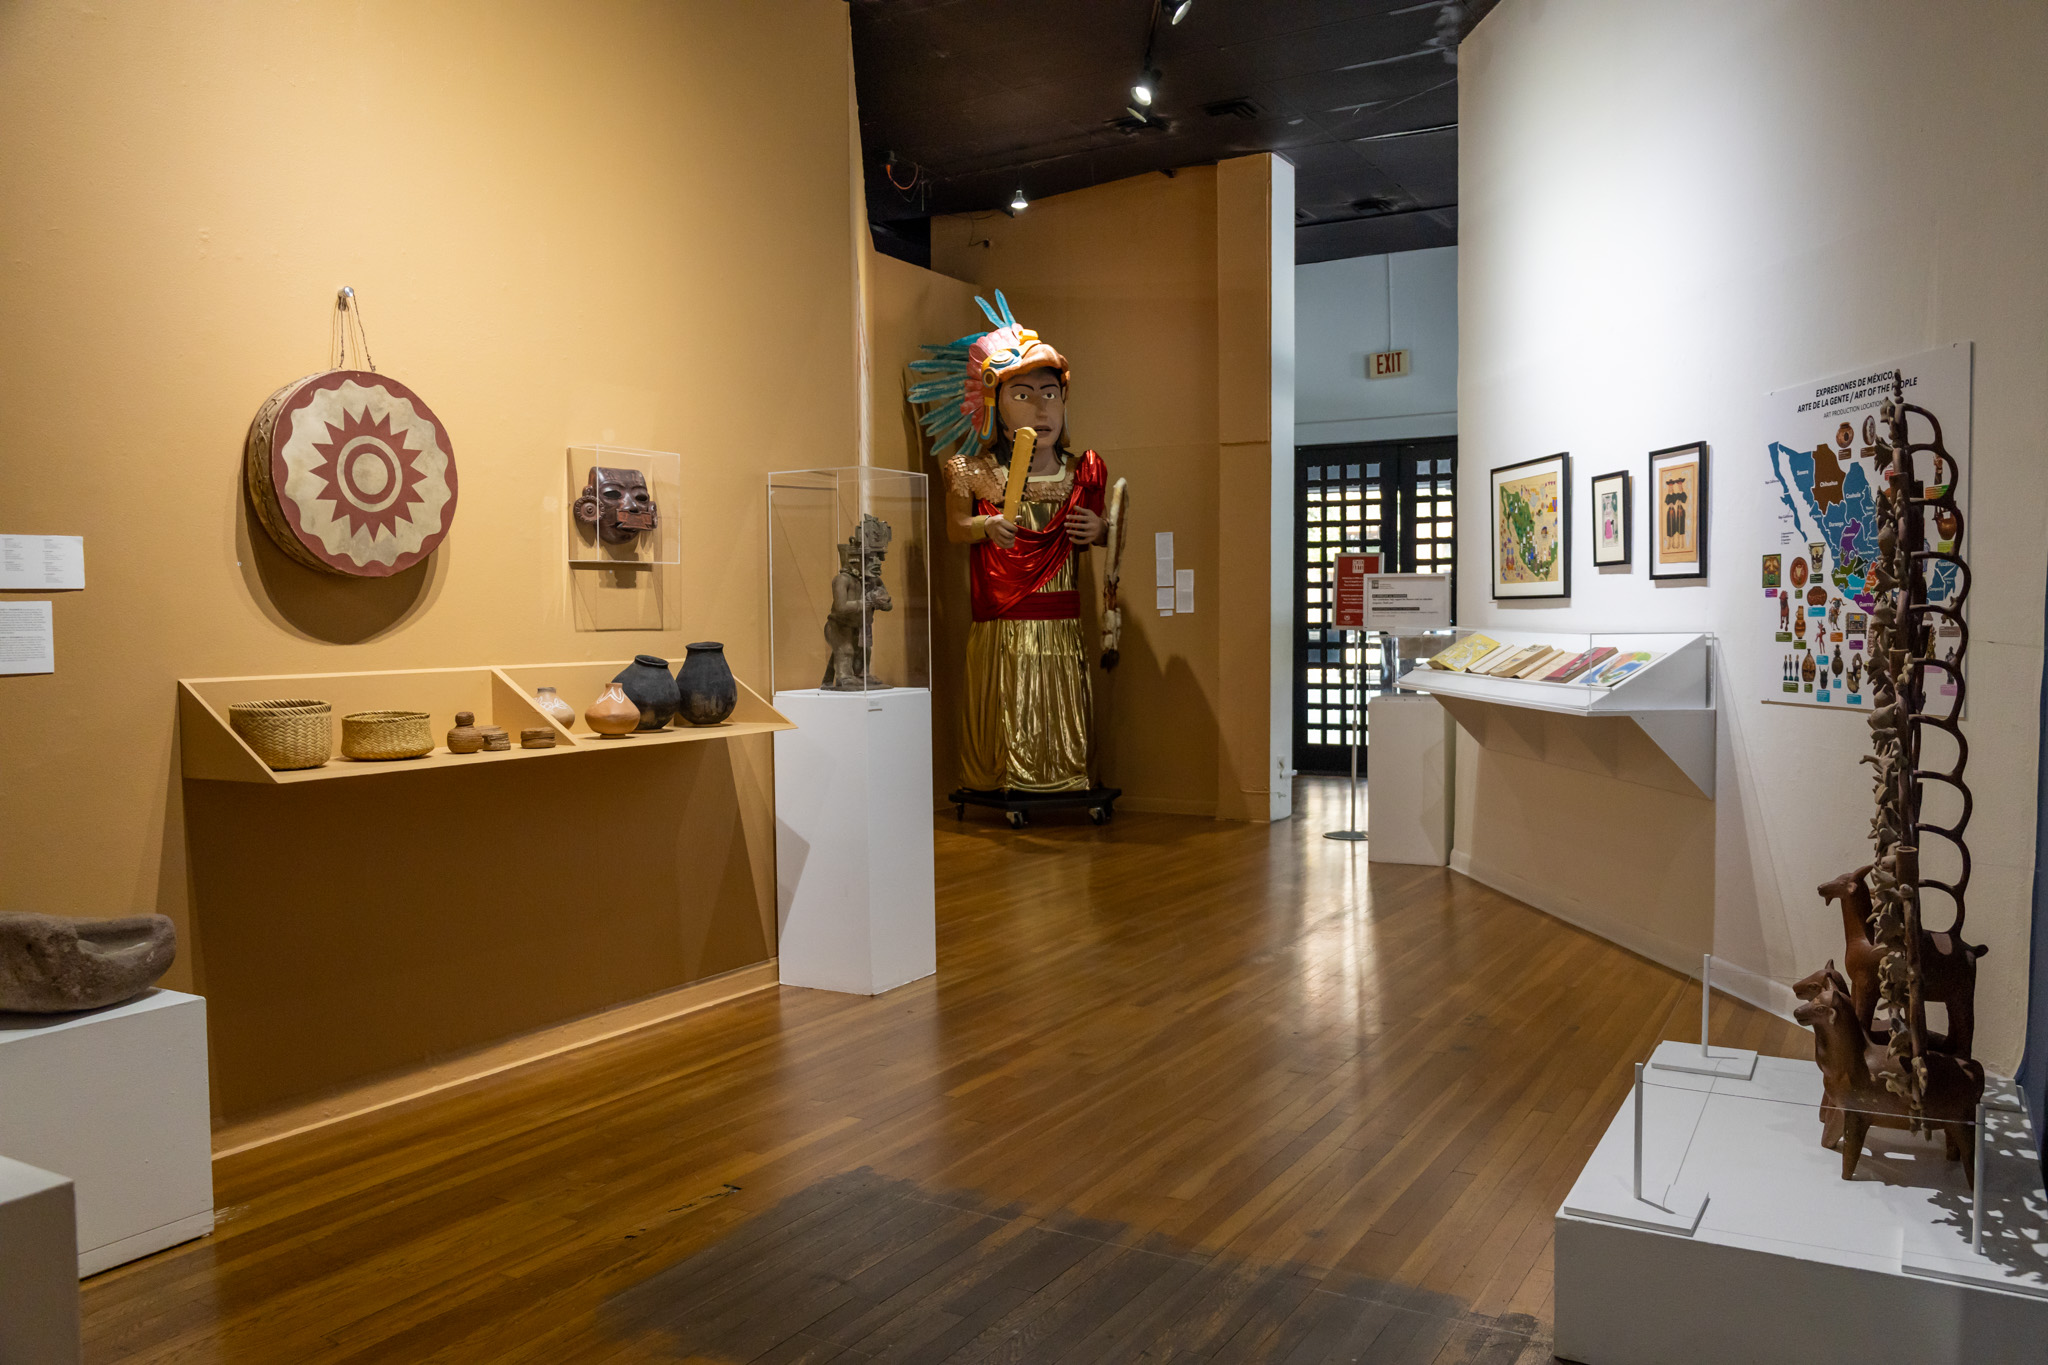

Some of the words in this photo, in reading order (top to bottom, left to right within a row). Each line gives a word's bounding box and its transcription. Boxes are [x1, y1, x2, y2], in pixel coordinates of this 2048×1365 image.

[1376, 351, 1402, 375] EXIT
[1797, 402, 1812, 413] ARTE
[1812, 400, 1821, 410] DE
[1821, 398, 1829, 408] LA
[1829, 393, 1850, 406] GENTE
[1849, 391, 1855, 404] /
[1854, 389, 1867, 400] ART
[1867, 386, 1877, 397] OF
[1877, 383, 1891, 394] THE
[1815, 379, 1857, 398] EXPRESIONES
[1857, 377, 1866, 387] DE
[1832, 405, 1860, 417] PRODUCTION
